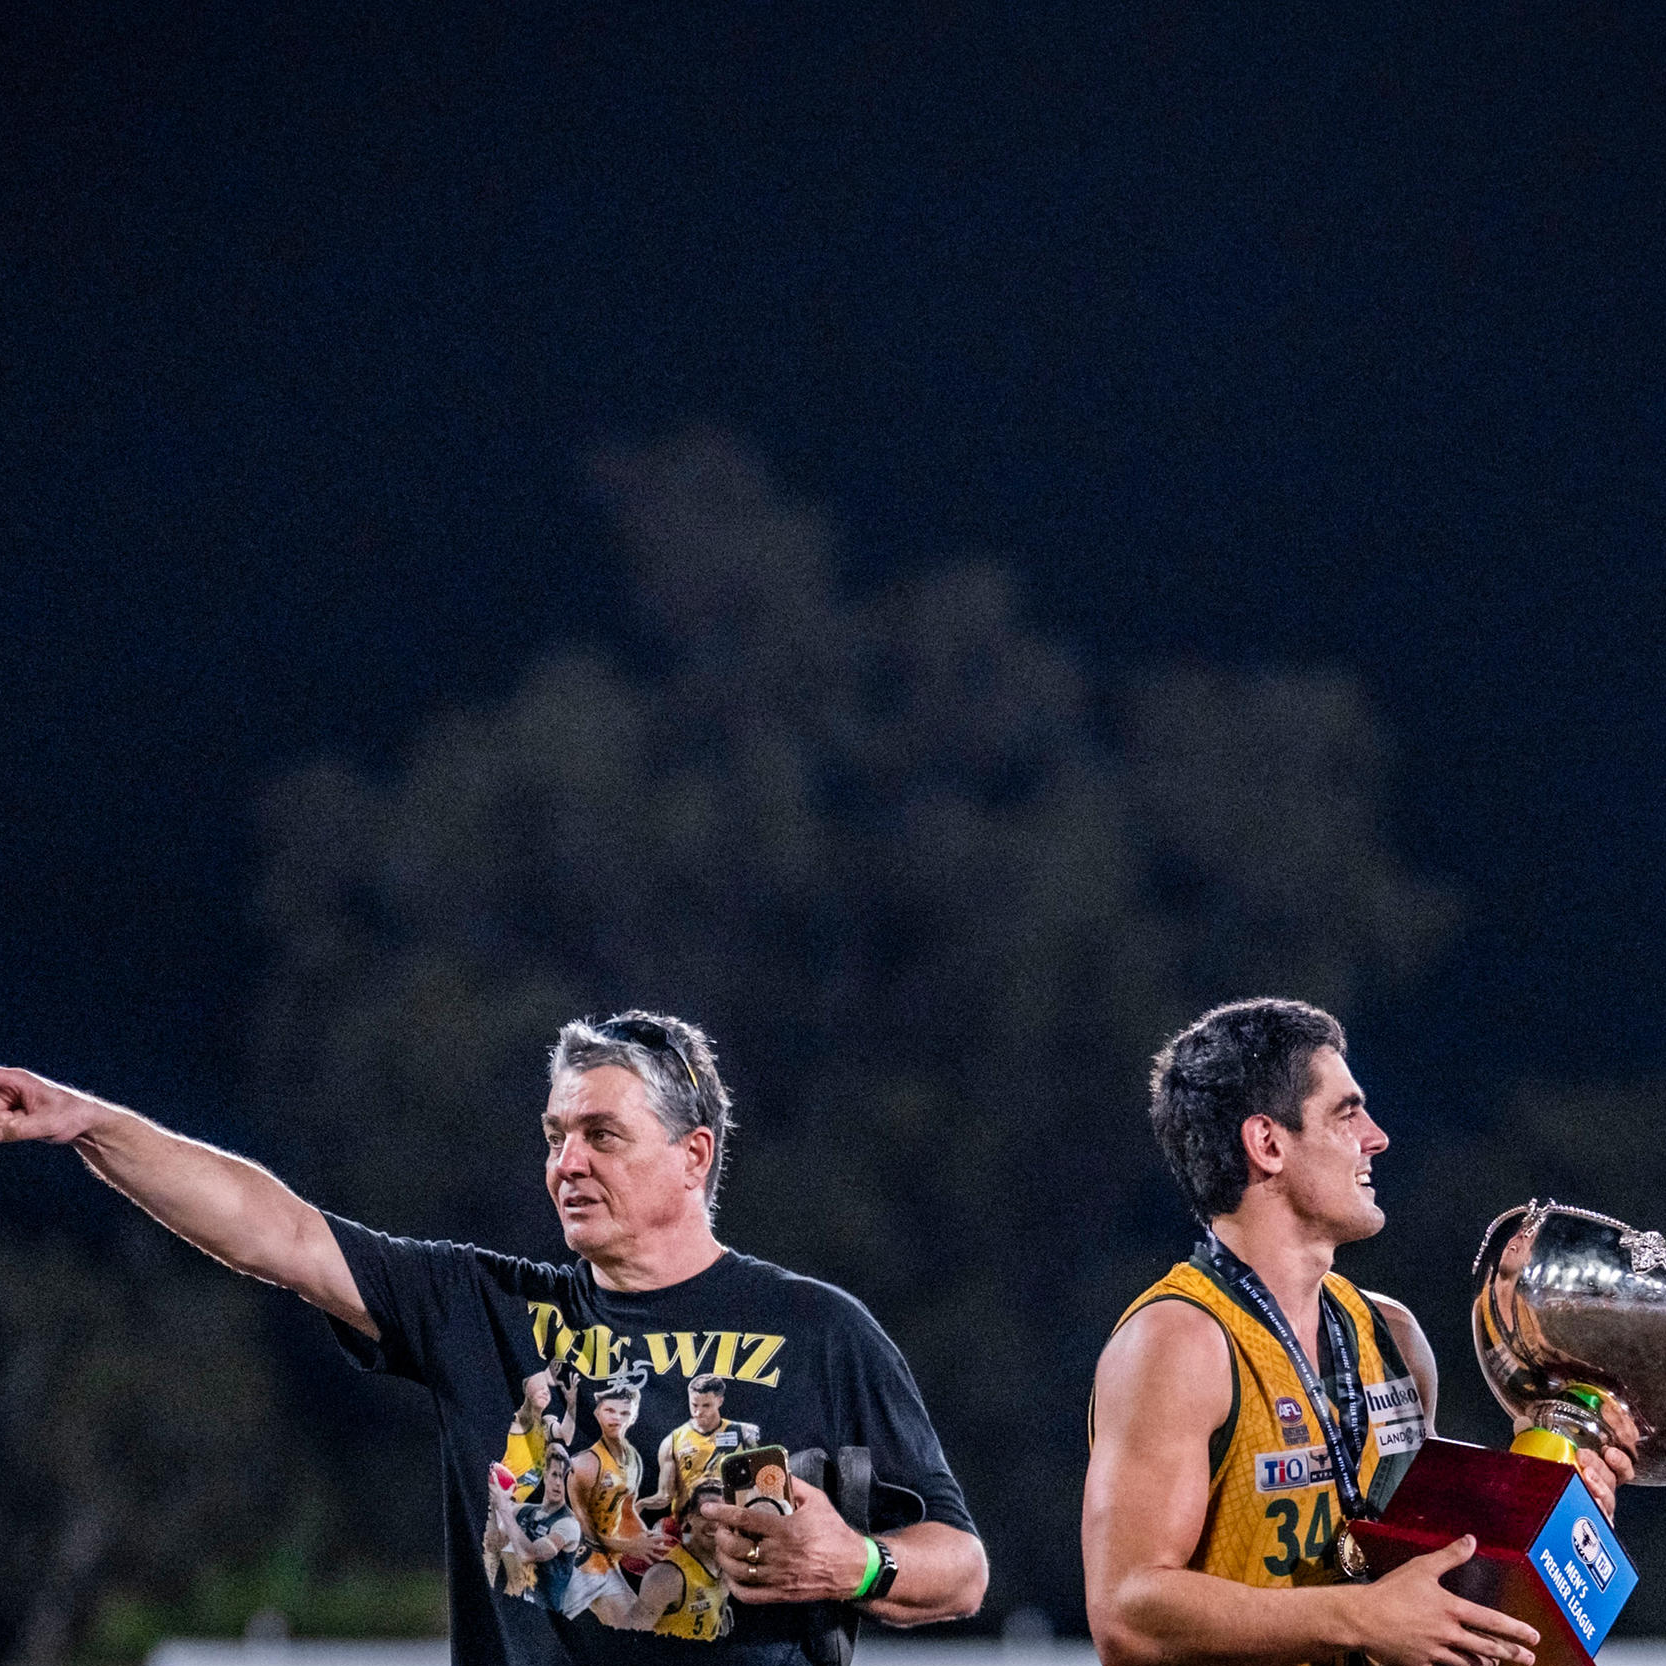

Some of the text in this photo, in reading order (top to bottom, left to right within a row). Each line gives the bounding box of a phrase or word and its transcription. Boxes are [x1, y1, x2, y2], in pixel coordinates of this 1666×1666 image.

[1267, 1311, 1289, 1338] PREMIERS
[527, 1301, 786, 1388] THE WIZ
[1278, 1403, 1302, 1417] AFL
[1366, 1385, 1421, 1412] hudso
[1264, 1458, 1303, 1485] TiO
[1263, 1491, 1334, 1577] 34
[1564, 1559, 1589, 1599] MEN'S
[1540, 1549, 1569, 1599] PREMIER
[1568, 1595, 1596, 1640] LEAGUE
[693, 1613, 704, 1635] 5
